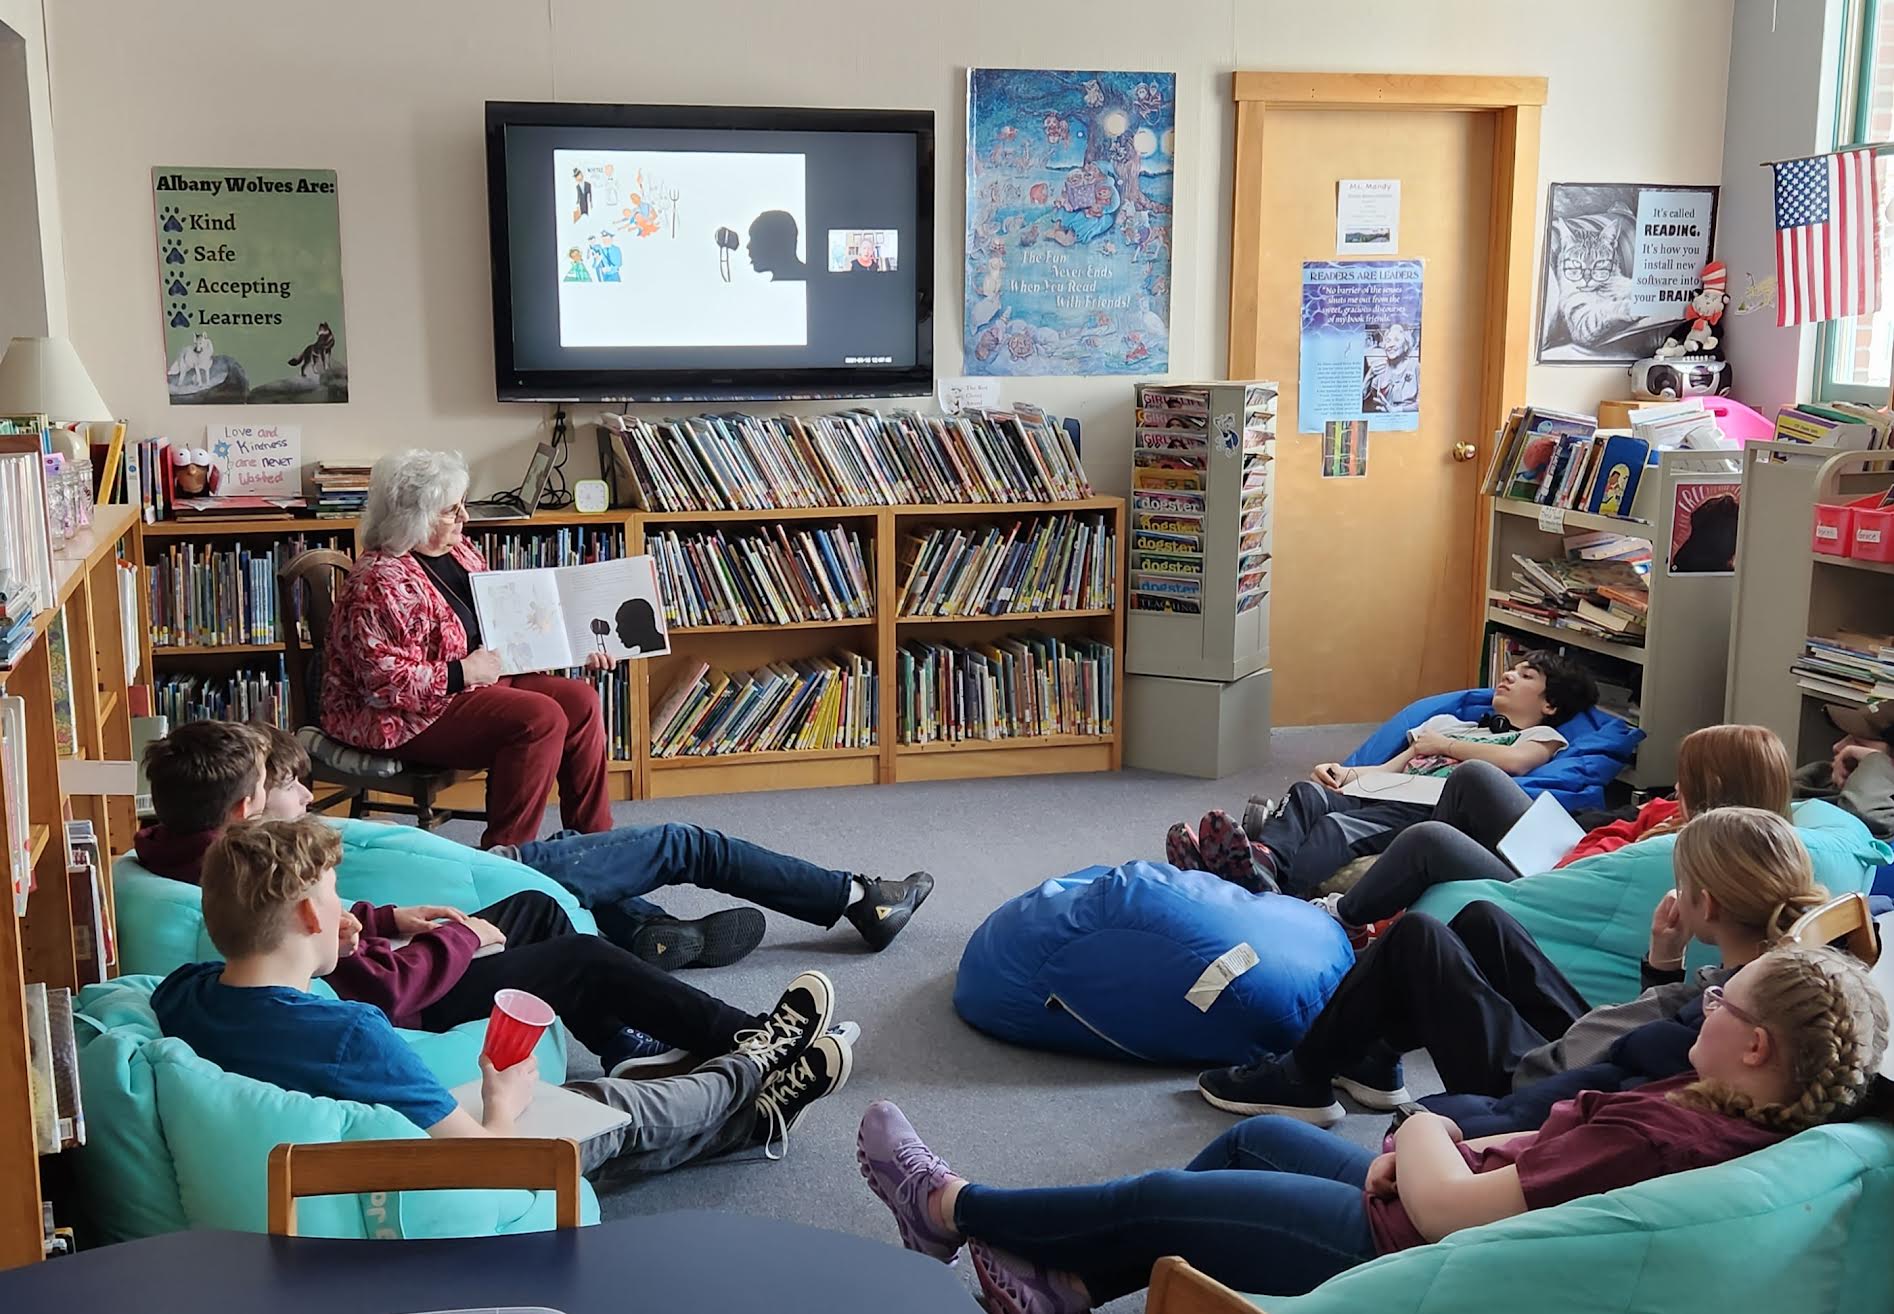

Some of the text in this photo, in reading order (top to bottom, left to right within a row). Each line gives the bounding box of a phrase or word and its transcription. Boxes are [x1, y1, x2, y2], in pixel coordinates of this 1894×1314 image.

[156, 175, 335, 196] Albany Wolves Are:
[1365, 183, 1392, 191] Mandy
[1653, 208, 1695, 218] It's called
[189, 213, 237, 231] Kind
[1644, 224, 1700, 237] READING.
[194, 244, 236, 262] Safe
[1021, 250, 1067, 264] The Fun
[1642, 243, 1700, 257] It's how you
[1644, 258, 1697, 270] install new
[1086, 264, 1113, 279] Ends
[1310, 270, 1420, 281] READERS ARE LEADERS
[1009, 280, 1040, 293] When
[1067, 279, 1097, 293] Read
[1636, 274, 1700, 285] software into
[195, 277, 291, 299] Accepting
[1337, 285, 1361, 294] barrier
[1084, 295, 1131, 308] Friends!
[1633, 292, 1656, 304] your
[198, 309, 282, 325] Learners
[1336, 316, 1347, 325] my
[224, 426, 279, 438] Love and
[236, 439, 288, 454] Kindness
[235, 457, 293, 468] are never
[1141, 497, 1200, 512] dogster
[1137, 537, 1196, 553] dogster
[1141, 559, 1200, 574] dogster
